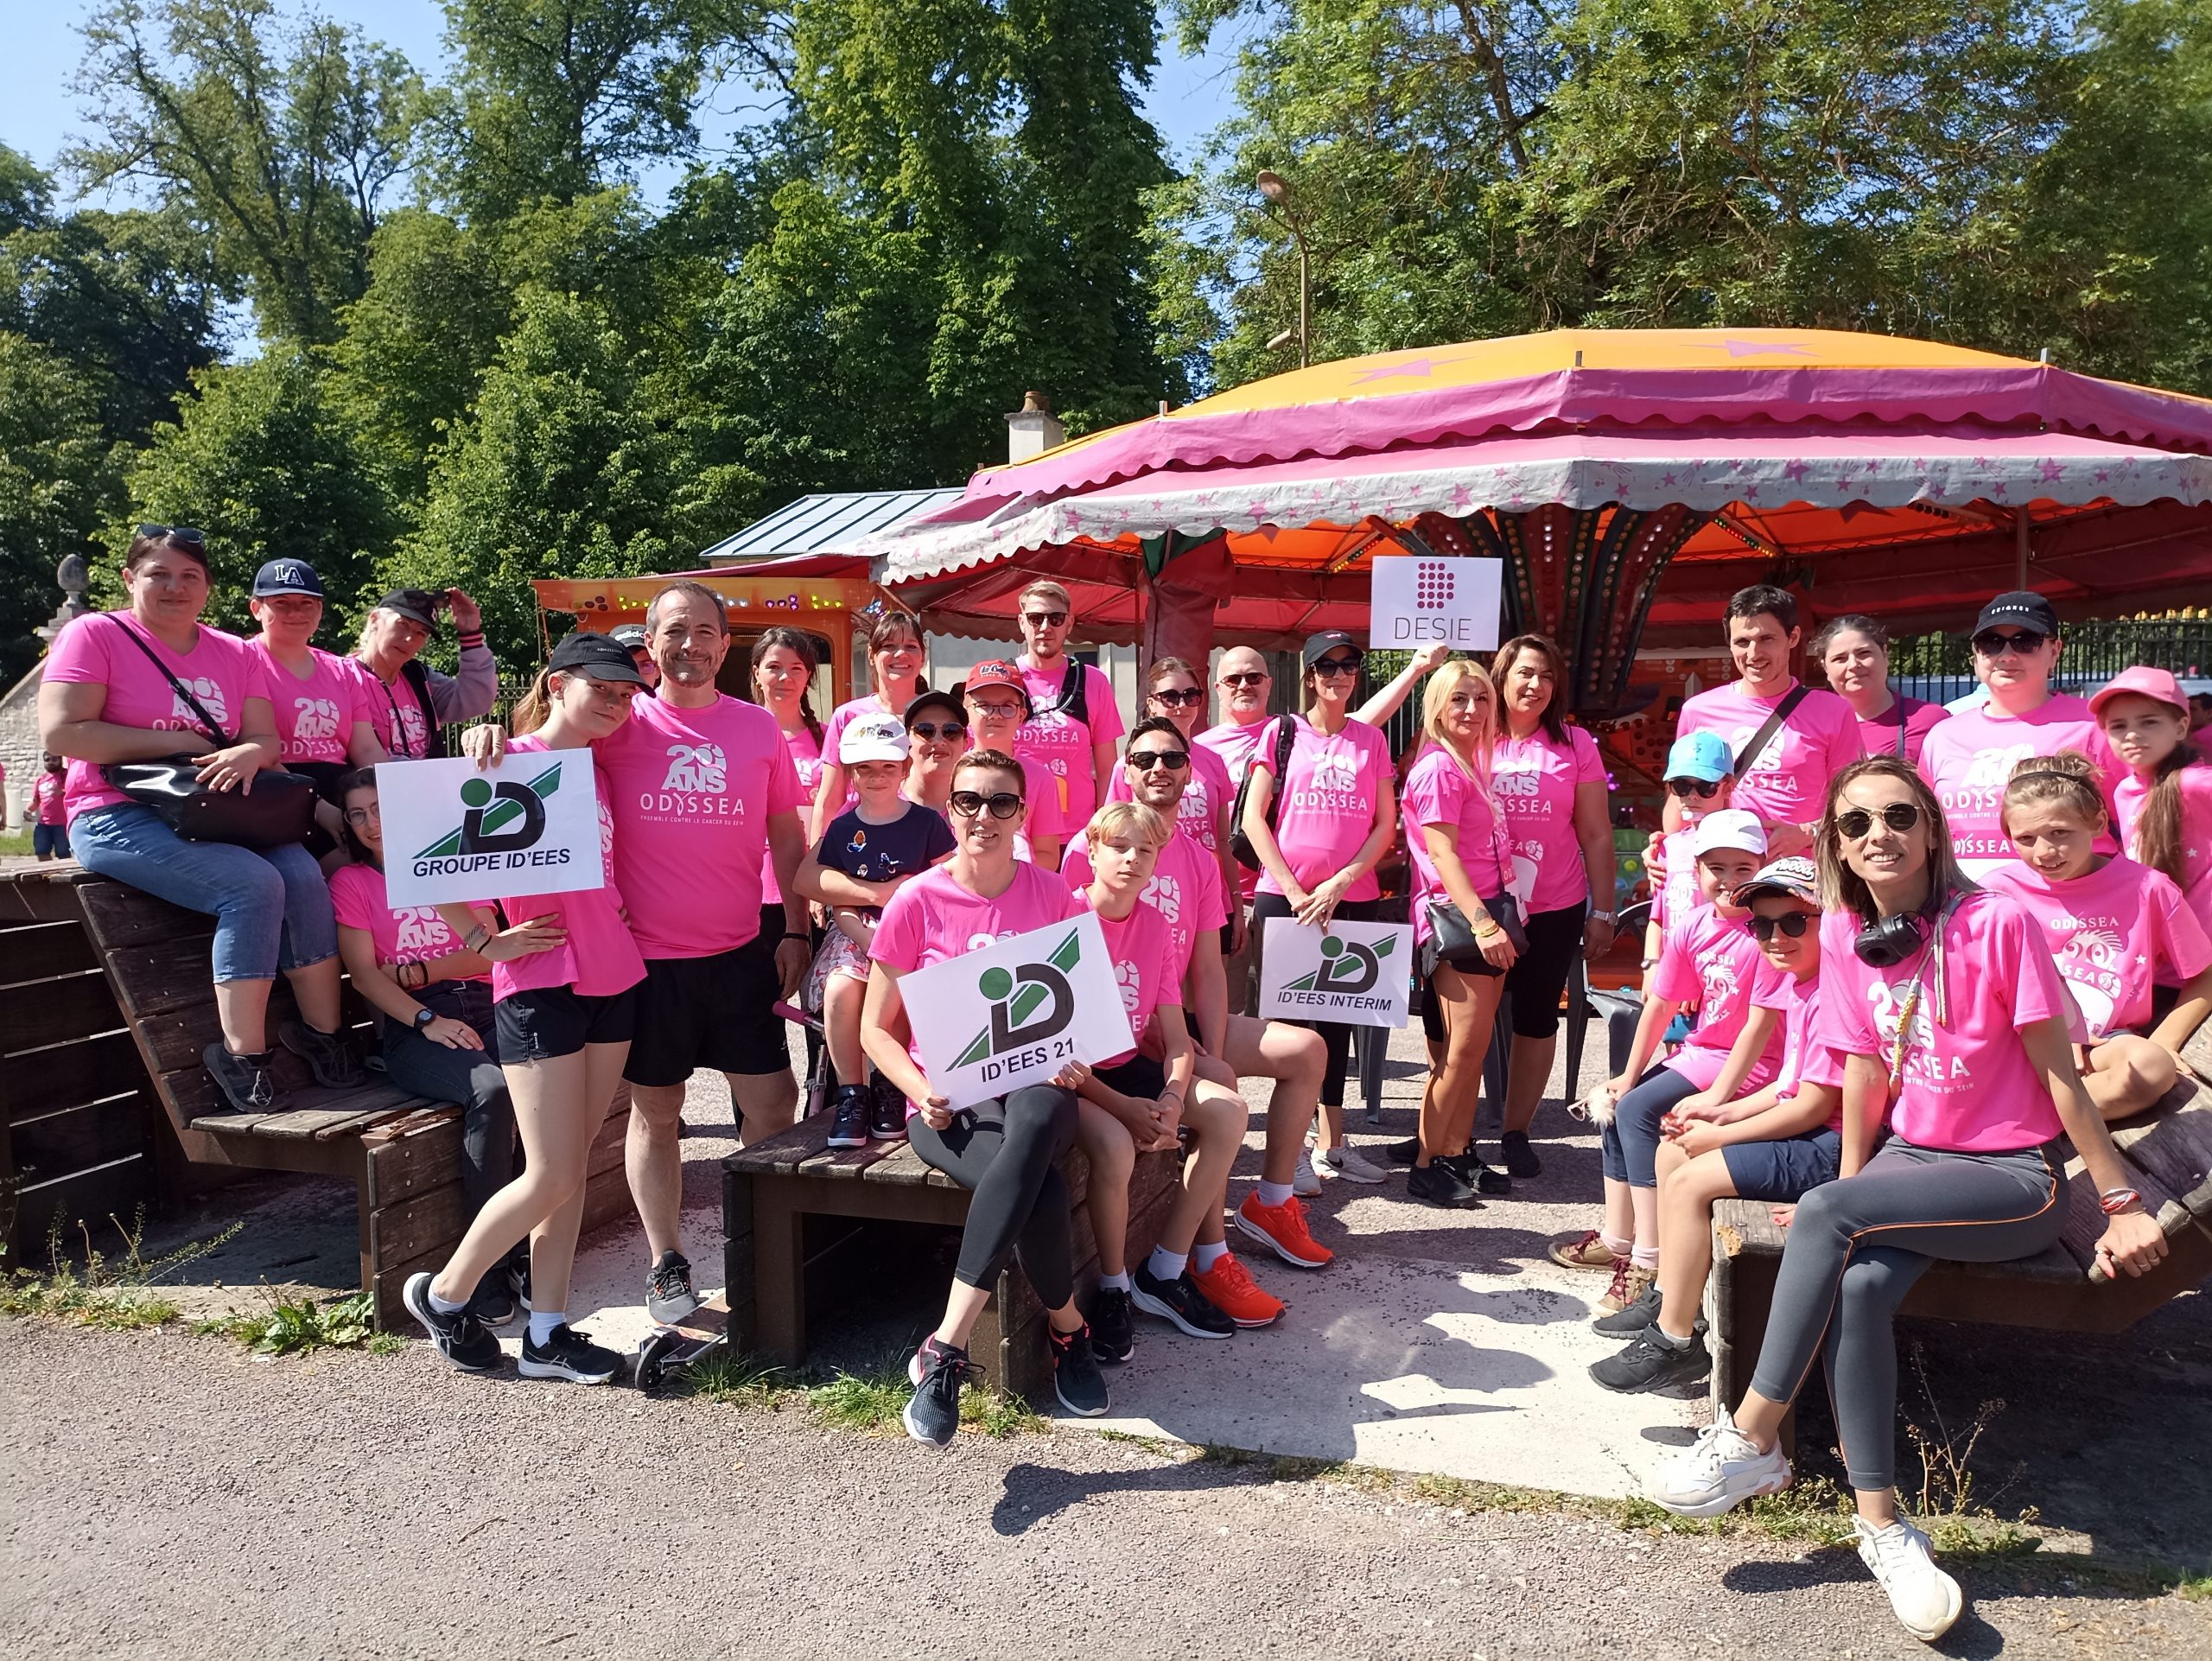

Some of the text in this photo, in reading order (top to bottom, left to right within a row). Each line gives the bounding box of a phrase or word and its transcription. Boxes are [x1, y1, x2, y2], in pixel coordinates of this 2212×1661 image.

[275, 564, 304, 585] LA
[1395, 617, 1471, 640] DESIE
[661, 764, 727, 793] ANS
[1738, 772, 1798, 792] SSEA
[640, 789, 745, 816] ODYSSEA
[1294, 790, 1367, 811] ODYSSEA
[1506, 799, 1552, 814] SSEA
[1942, 787, 1998, 811] ODYS
[1953, 833, 2011, 856] DYSSEA
[413, 849, 570, 877] GROUPE ID'EES
[396, 920, 450, 951] ANS
[1277, 991, 1392, 1011] ID'EES INTERIM
[981, 1038, 1074, 1083] ID'EES 21
